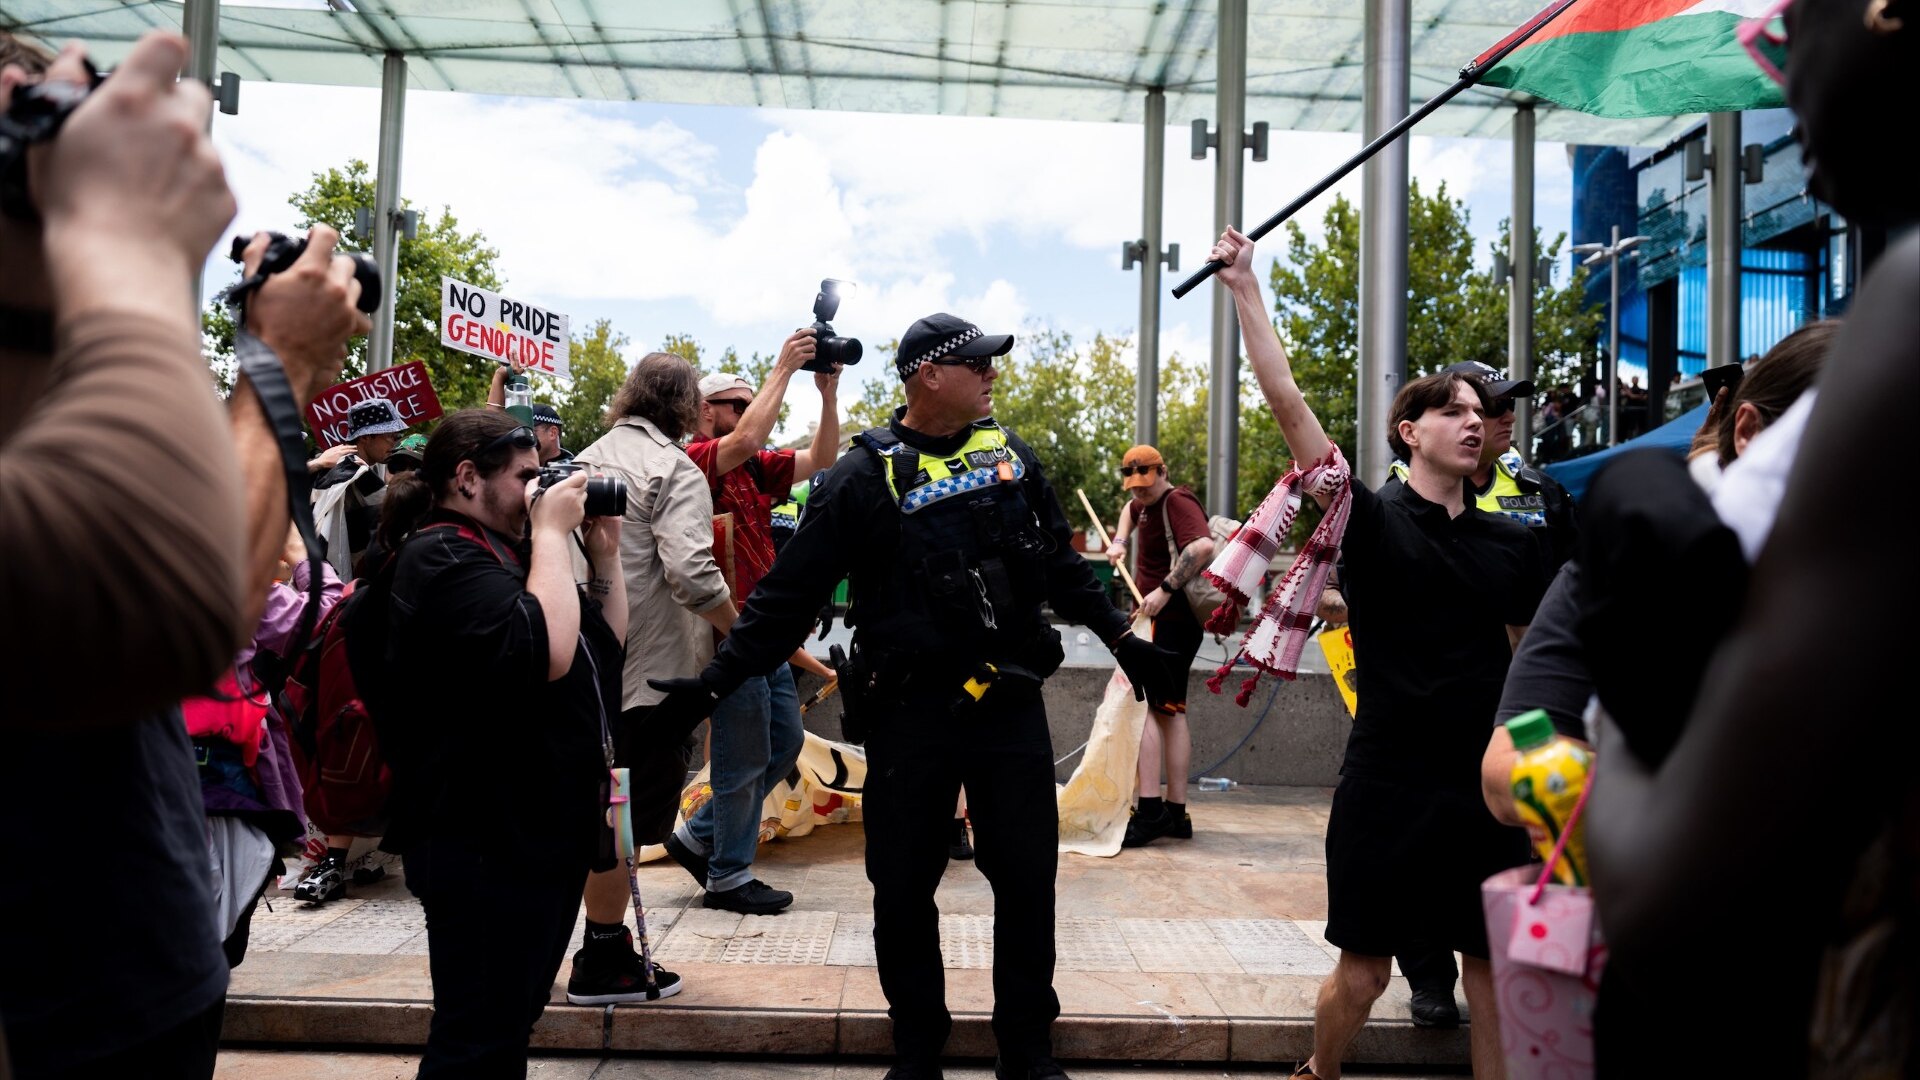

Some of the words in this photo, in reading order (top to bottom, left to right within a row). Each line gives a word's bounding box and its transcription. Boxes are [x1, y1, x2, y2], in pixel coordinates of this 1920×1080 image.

[449, 283, 486, 318] NO
[500, 298, 560, 342] PRIDE
[447, 314, 555, 372] GENOCIDE
[312, 391, 352, 421] NO
[349, 366, 422, 403] JUSTICE
[1501, 495, 1544, 507] POLICE
